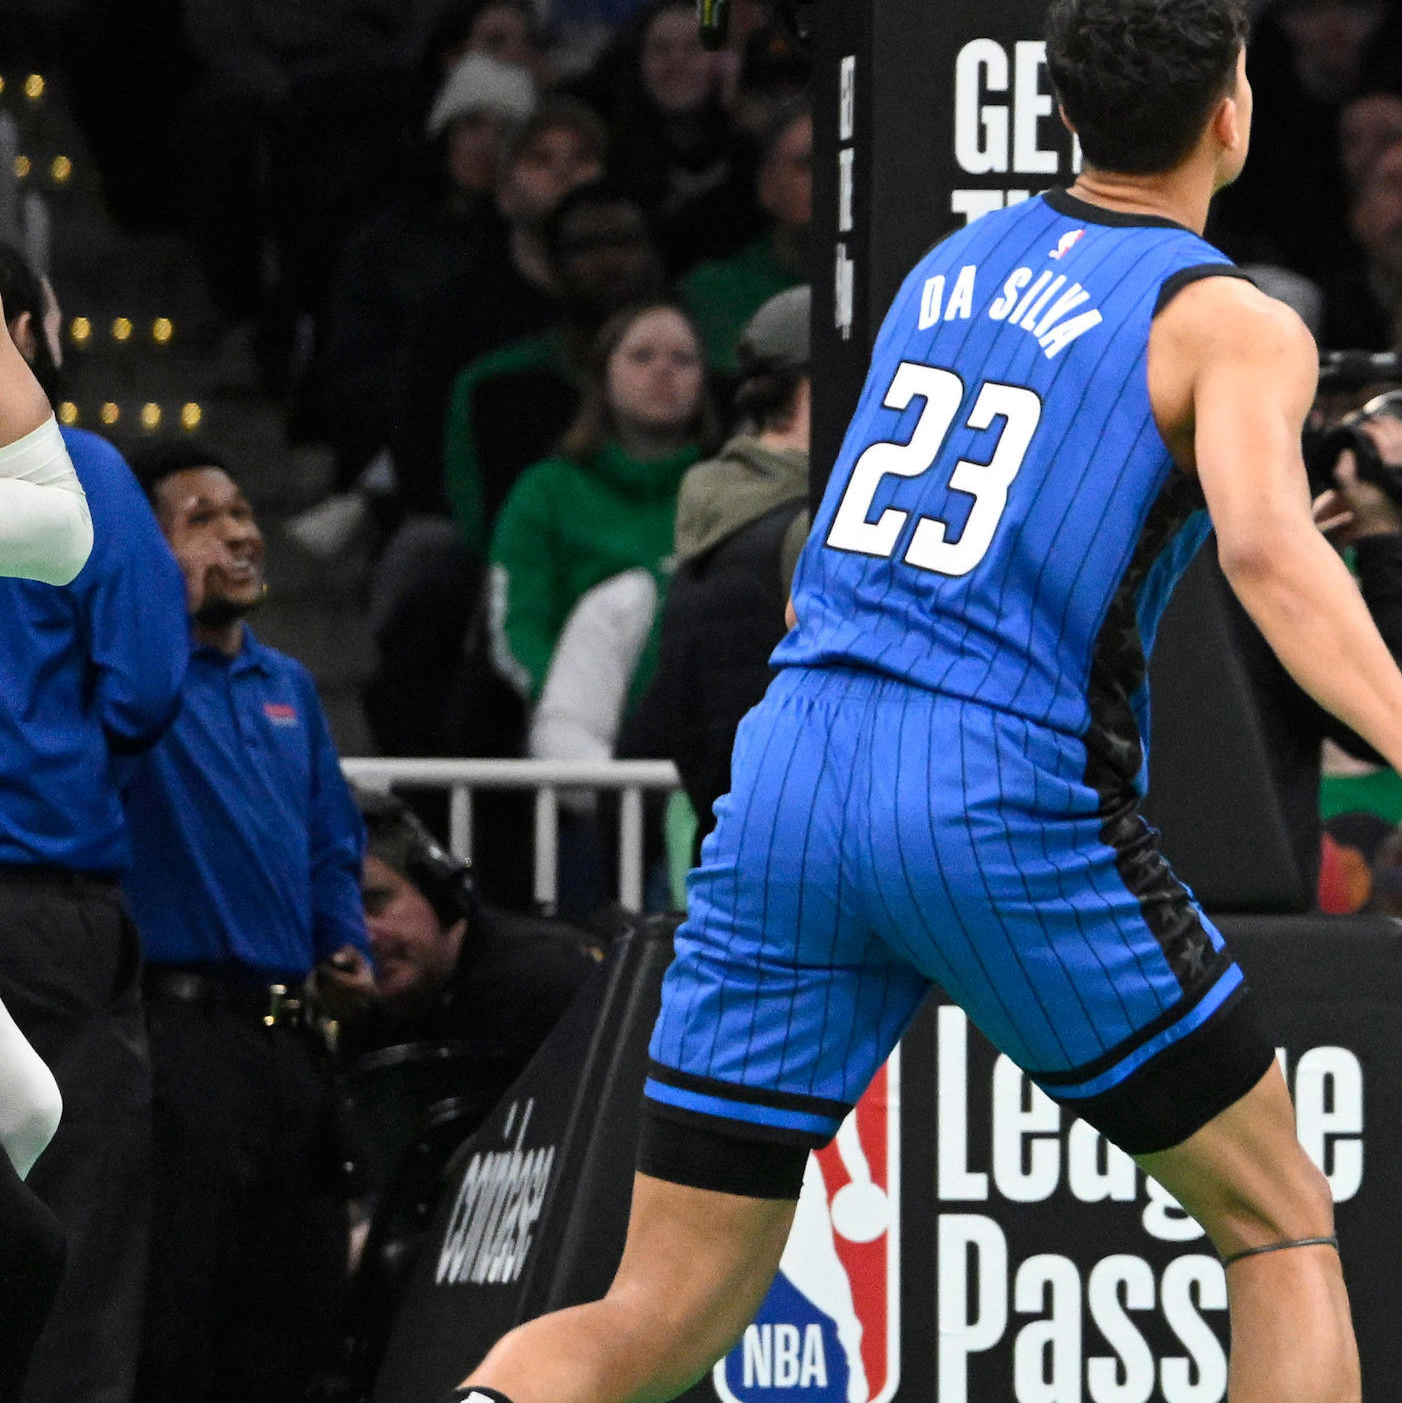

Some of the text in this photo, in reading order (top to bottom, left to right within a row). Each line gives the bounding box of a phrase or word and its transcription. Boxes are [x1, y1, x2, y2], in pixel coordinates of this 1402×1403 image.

[955, 38, 1083, 175] GE
[918, 264, 973, 330] DA
[989, 267, 1101, 359] SILVA
[825, 360, 1043, 577] 23
[938, 1005, 1363, 1242] Leae
[742, 1324, 828, 1388] NBA
[938, 1214, 1229, 1403] Pass
